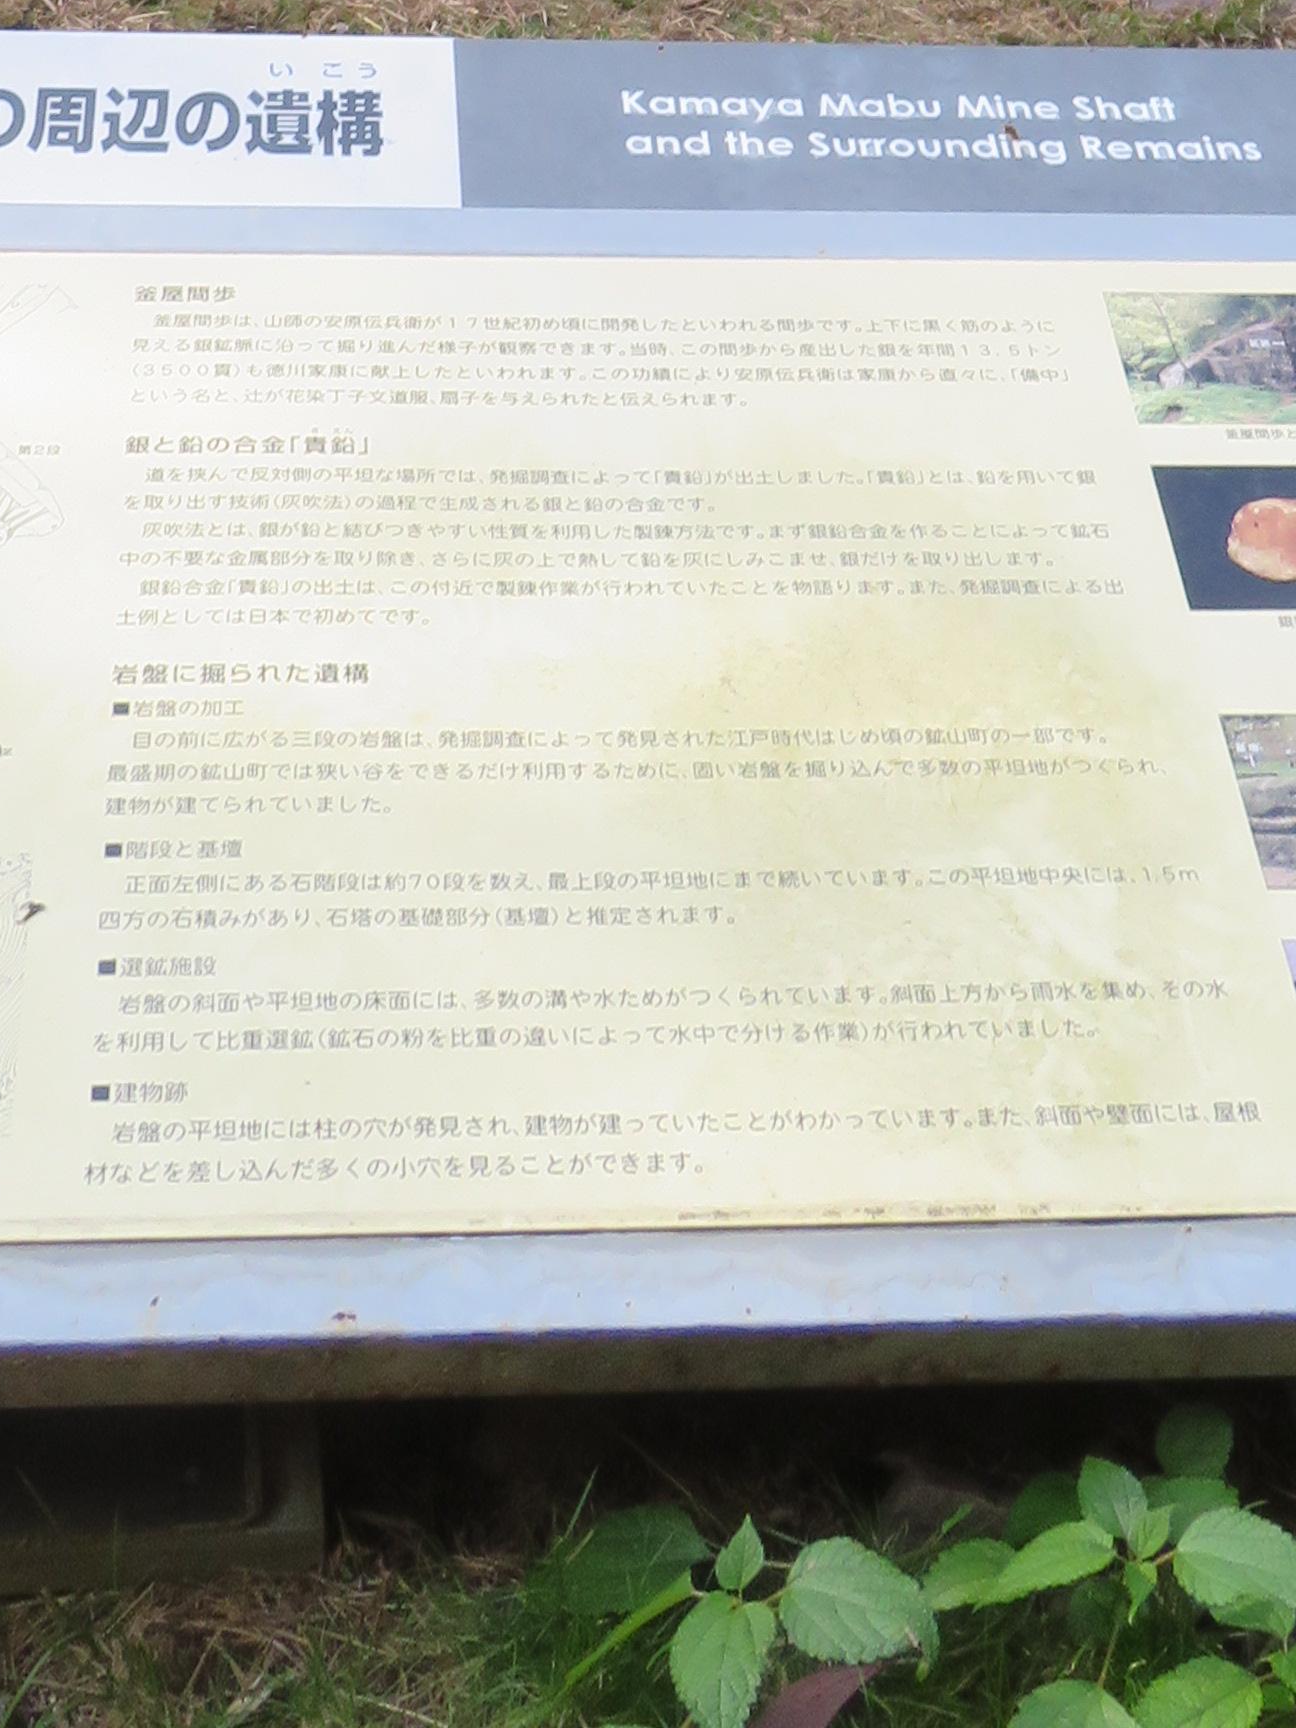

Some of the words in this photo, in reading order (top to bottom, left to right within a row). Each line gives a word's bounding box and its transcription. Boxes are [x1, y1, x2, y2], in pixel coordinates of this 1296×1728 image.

[621, 90, 804, 123] Kamaya
[819, 92, 943, 119] Mabu
[957, 94, 1060, 121] Mine
[1072, 95, 1177, 122] Shaft
[624, 130, 711, 158] and
[724, 130, 795, 158] the
[808, 131, 1068, 165] Surrounding
[1081, 135, 1262, 162] Remains
[135, 284, 237, 304] 釜屋間歩
[125, 435, 371, 456] 銀と鉛の合金「貴鉛」
[116, 607, 432, 627] 土例としては日本で初めてです。
[111, 661, 370, 685] 岩盤に掘られた遺構
[104, 794, 393, 816] 建物が建てられていました。
